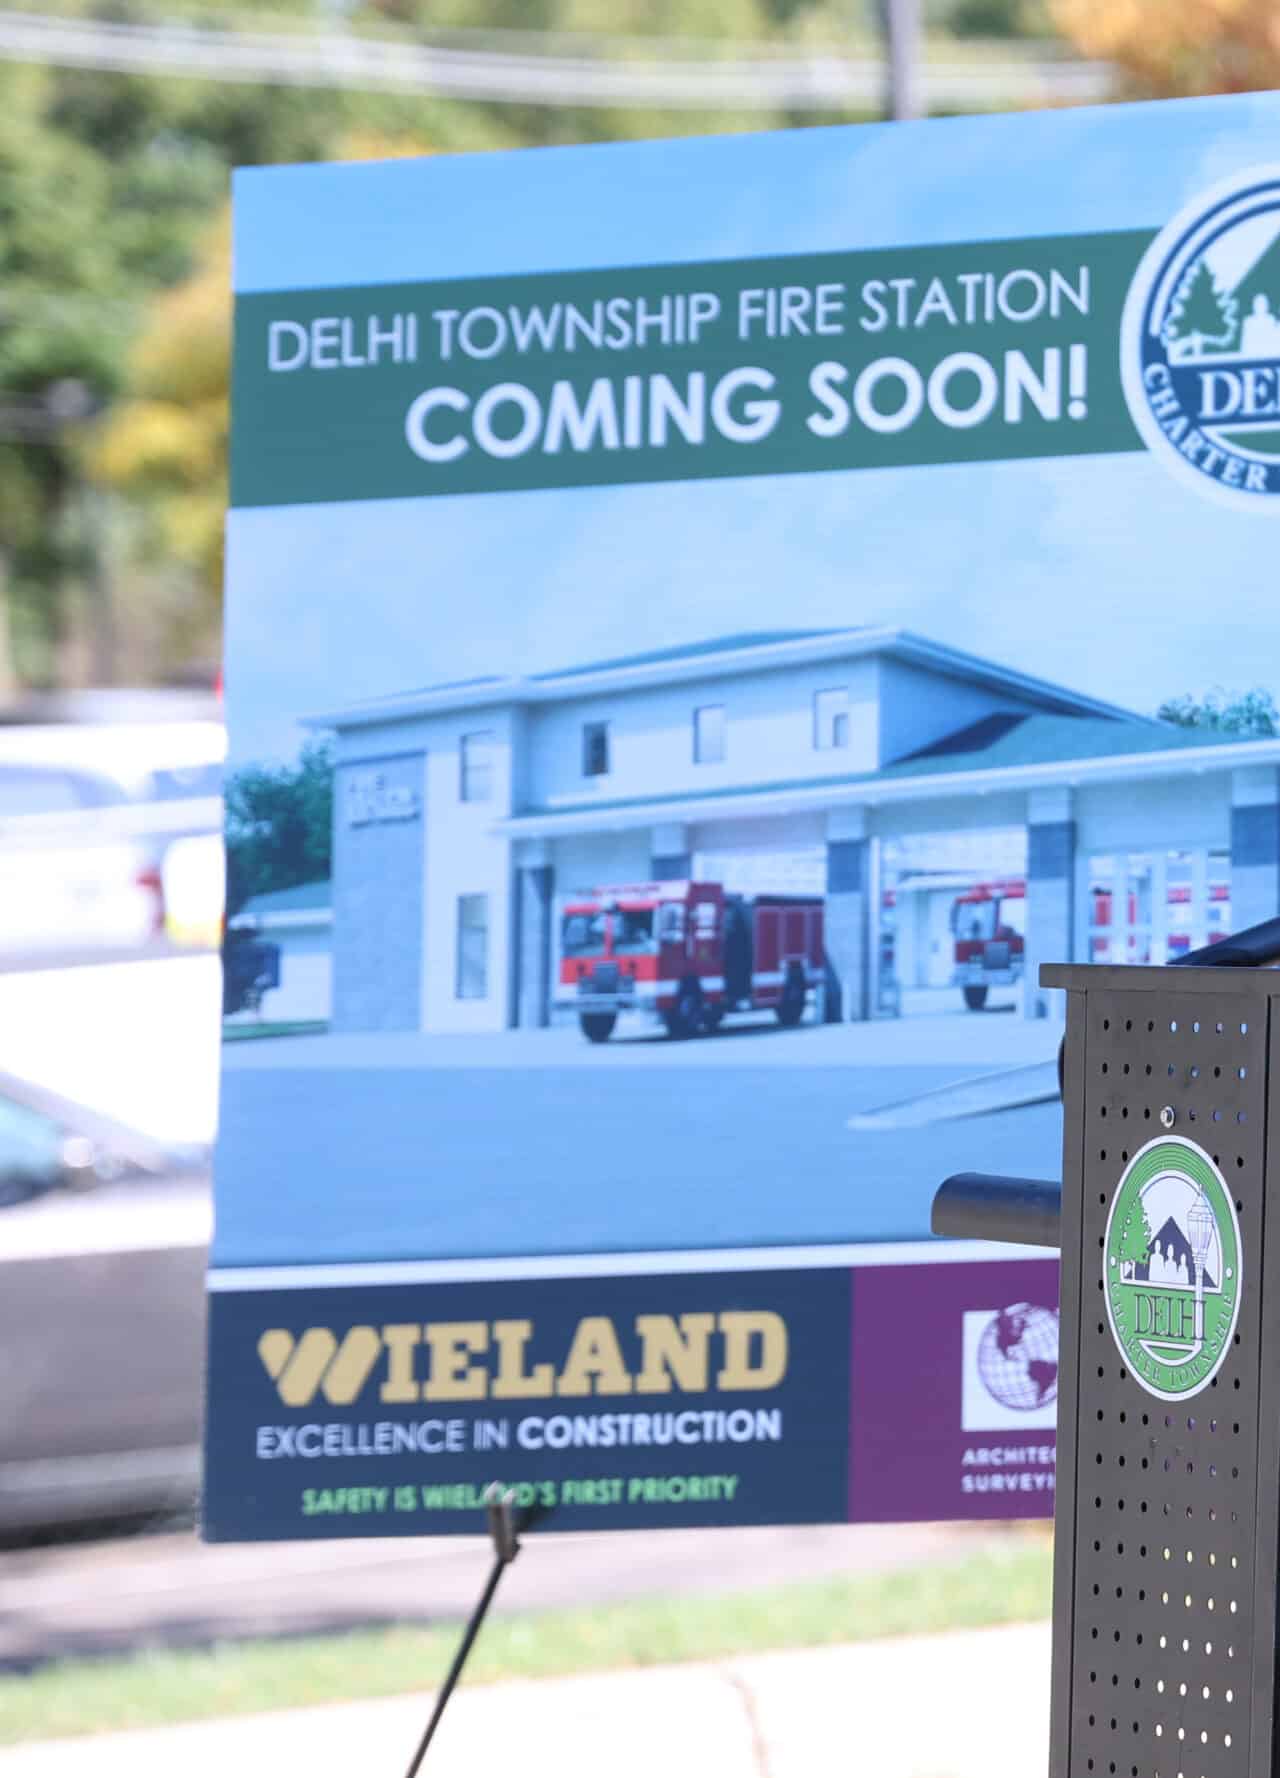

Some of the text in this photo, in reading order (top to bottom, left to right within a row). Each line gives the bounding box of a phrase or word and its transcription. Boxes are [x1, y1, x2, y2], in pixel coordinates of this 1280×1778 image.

[268, 265, 1089, 372] DELHI TOWNSHIP FIRE STATION
[404, 343, 1088, 463] COMING SOON!
[1143, 363, 1267, 491] CHARTER
[257, 1310, 788, 1407] WIELAND
[256, 1408, 782, 1460] EXCELLENCE IN CONSTRUCTION
[302, 1486, 388, 1516] SAFETY
[394, 1485, 416, 1513] IS
[561, 1478, 623, 1504] FIRST
[628, 1474, 738, 1504] PRIORITY
